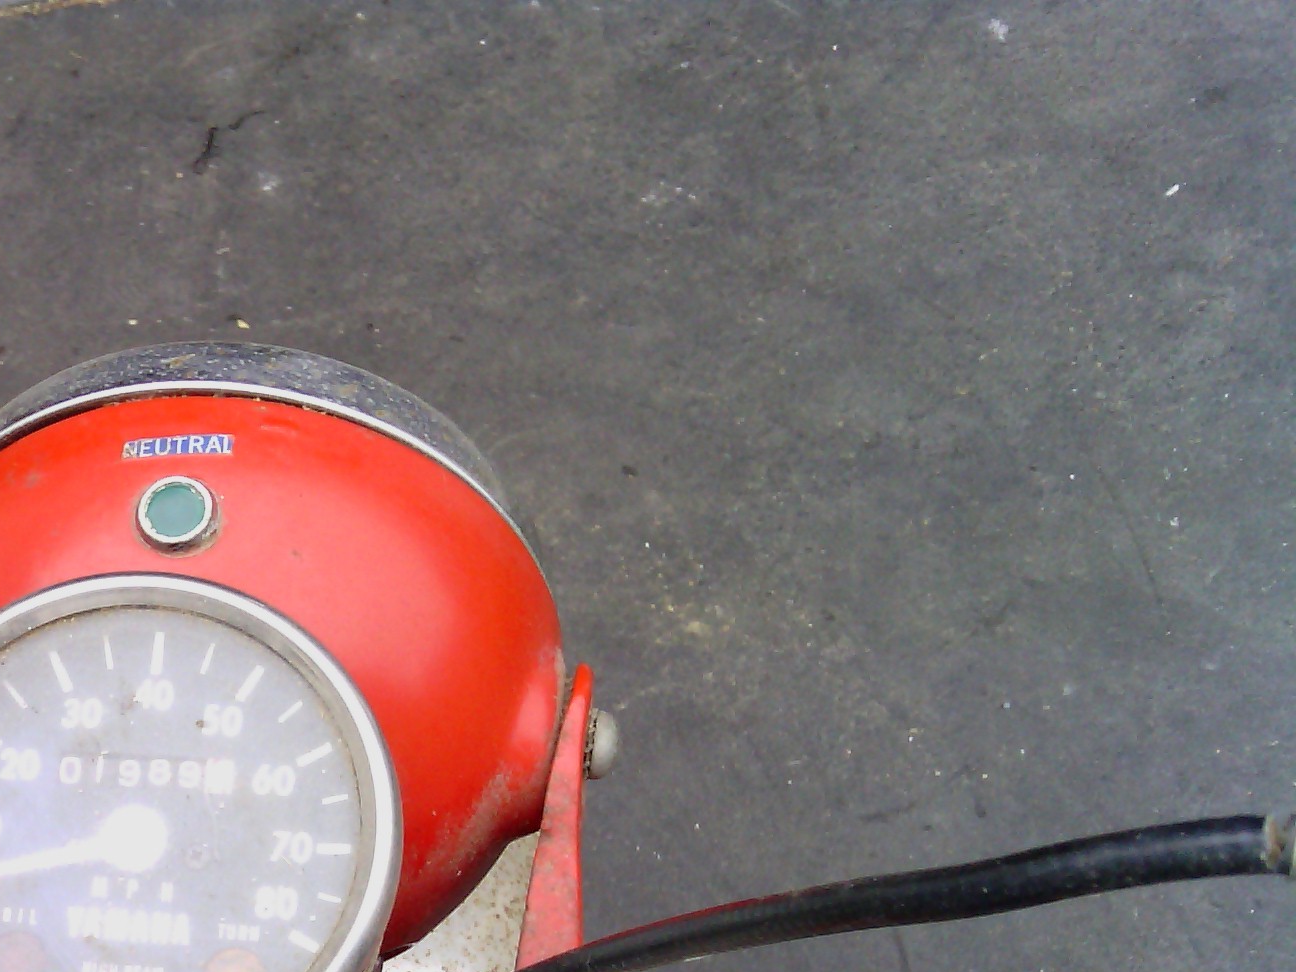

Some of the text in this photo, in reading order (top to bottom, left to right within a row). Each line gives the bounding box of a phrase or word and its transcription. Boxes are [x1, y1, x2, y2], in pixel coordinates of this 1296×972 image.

[123, 435, 232, 458] NEUTRAL
[136, 680, 175, 710] 40
[61, 697, 103, 730] 30
[201, 704, 244, 738] 50
[0, 747, 40, 781] 20
[252, 763, 296, 797] 60
[270, 831, 314, 863] 70
[2, 907, 37, 925] OIL
[255, 886, 299, 920] 80
[66, 905, 191, 946] YAMAHA
